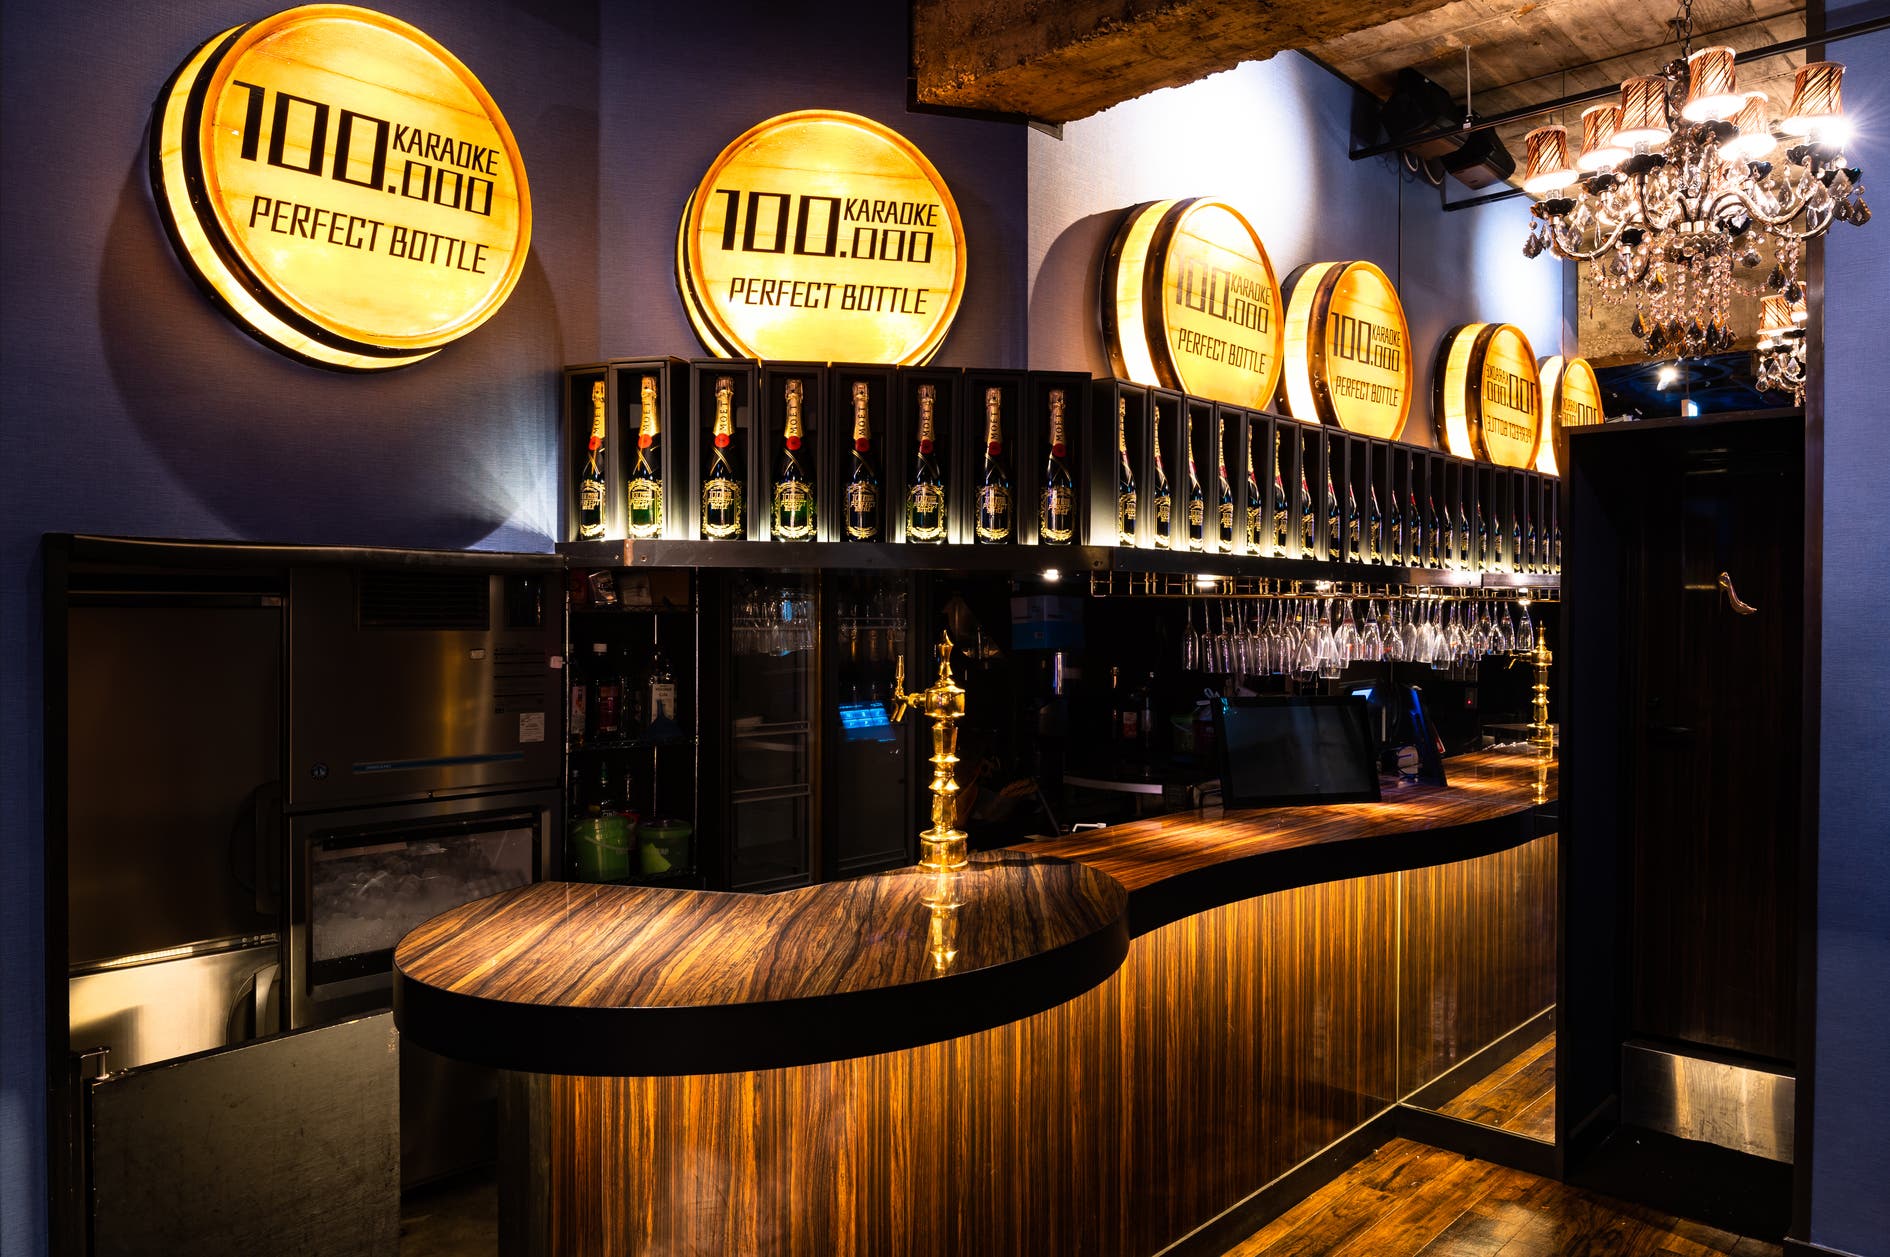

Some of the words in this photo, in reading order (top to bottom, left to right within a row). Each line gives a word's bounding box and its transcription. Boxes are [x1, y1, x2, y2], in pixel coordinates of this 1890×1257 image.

[232, 79, 494, 217] 100.000
[392, 123, 500, 176] KARAOKE
[716, 188, 934, 264] 100.000
[843, 197, 940, 227] KARAOKE
[249, 195, 385, 252] PERFECT
[388, 226, 490, 274] BOTTLE
[729, 277, 837, 309] PERFECT
[840, 284, 930, 315] BOTTLE
[1174, 254, 1269, 334] 100.000
[1230, 272, 1272, 306] KARAOKE
[1178, 327, 1228, 363] PERFECT
[1228, 343, 1267, 375] BOTTLE
[1330, 311, 1400, 372] 100.000
[1371, 323, 1401, 348] KARAOKE
[1335, 375, 1371, 403] PERFECT
[1370, 380, 1399, 407] BOTTLE
[790, 404, 799, 436] MOET
[858, 406, 867, 438] MOET
